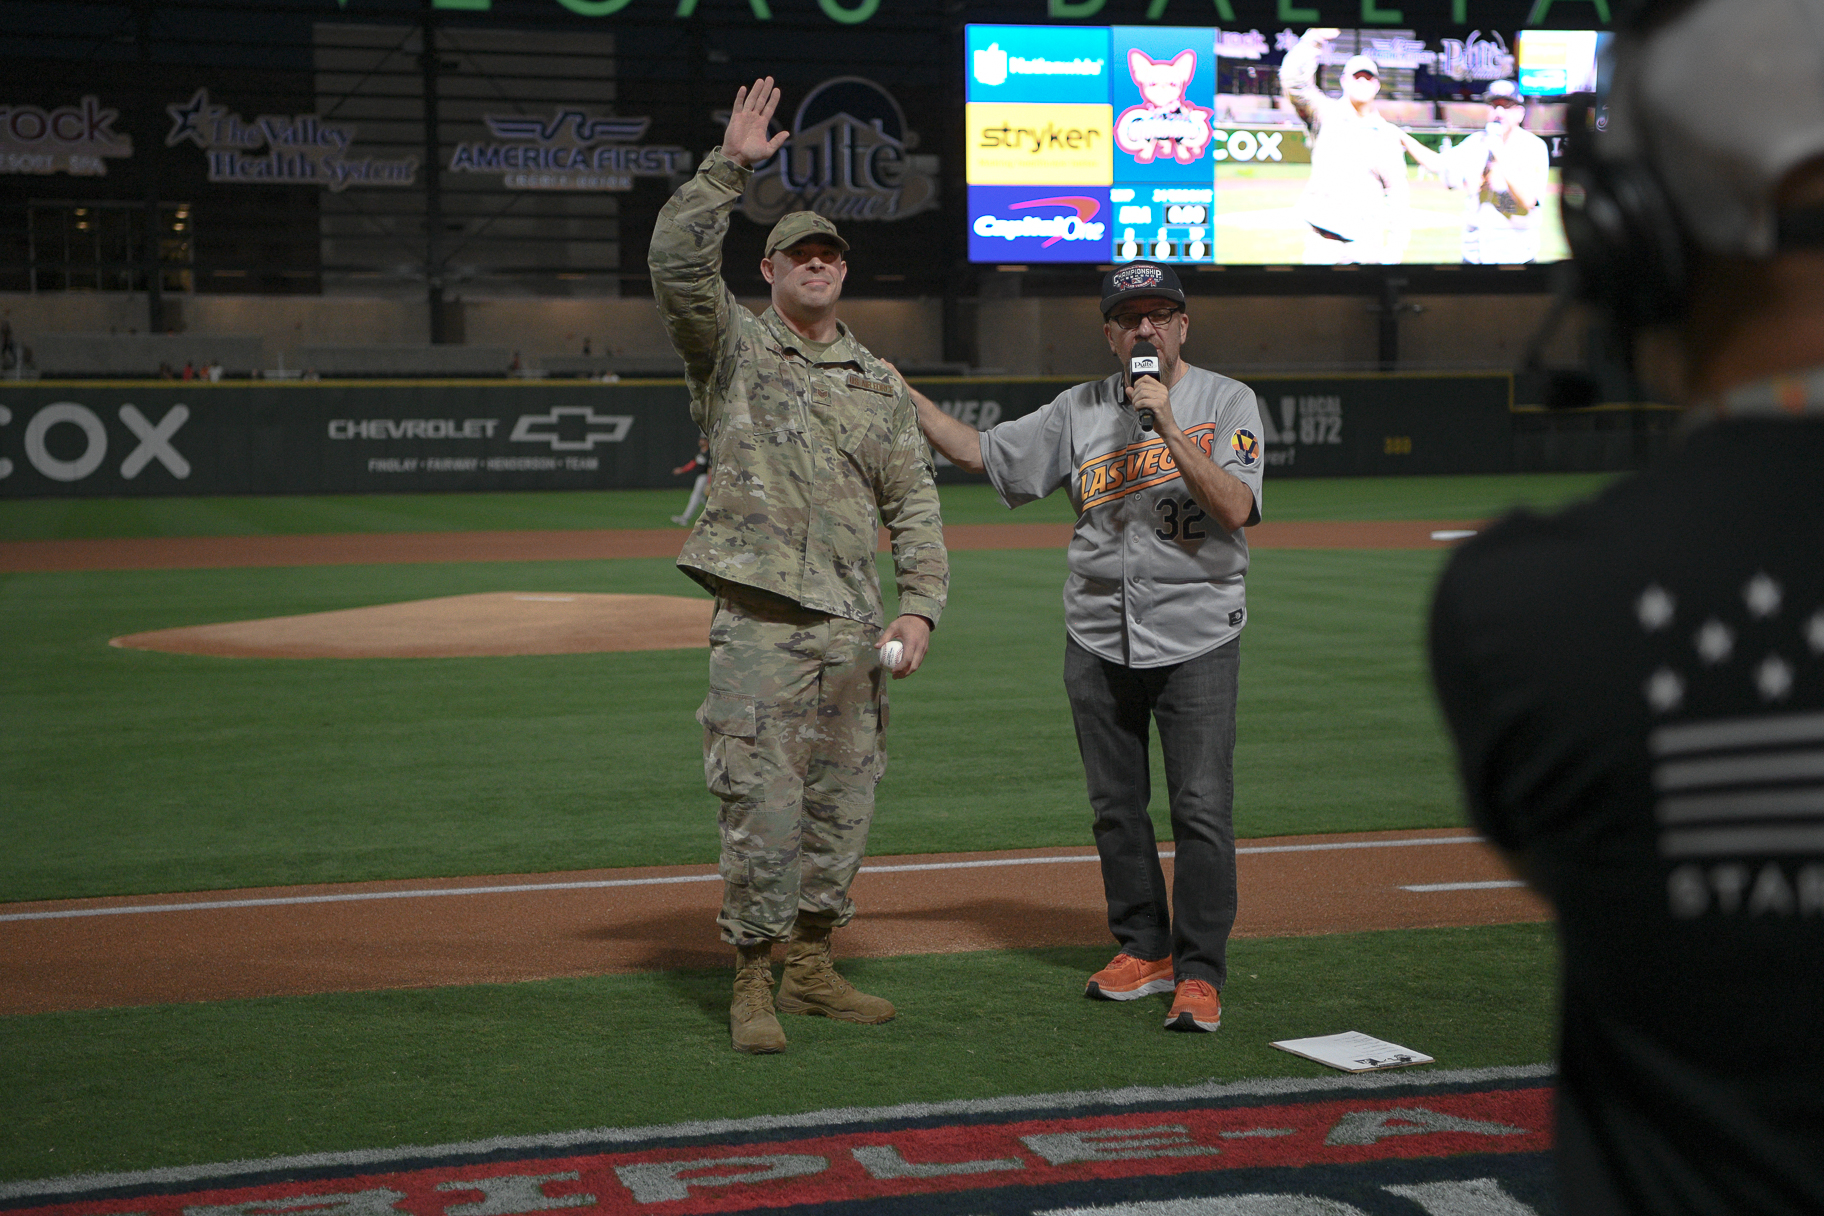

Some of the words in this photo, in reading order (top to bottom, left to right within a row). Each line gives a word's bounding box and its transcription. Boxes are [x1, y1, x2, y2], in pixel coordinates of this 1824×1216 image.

[0, 98, 114, 143] ock
[261, 114, 353, 153] Valley
[980, 121, 1100, 153] stryker
[209, 149, 315, 180] Health
[454, 145, 590, 172] AMERICA
[594, 148, 682, 174] FIRST
[0, 402, 191, 482] OX
[327, 418, 500, 440] CHEVROLET
[1298, 416, 1343, 445] 872
[564, 456, 599, 471] TEAM
[1081, 460, 1126, 502] LAS
[1126, 432, 1214, 483] VEGS
[1154, 496, 1207, 542] 32
